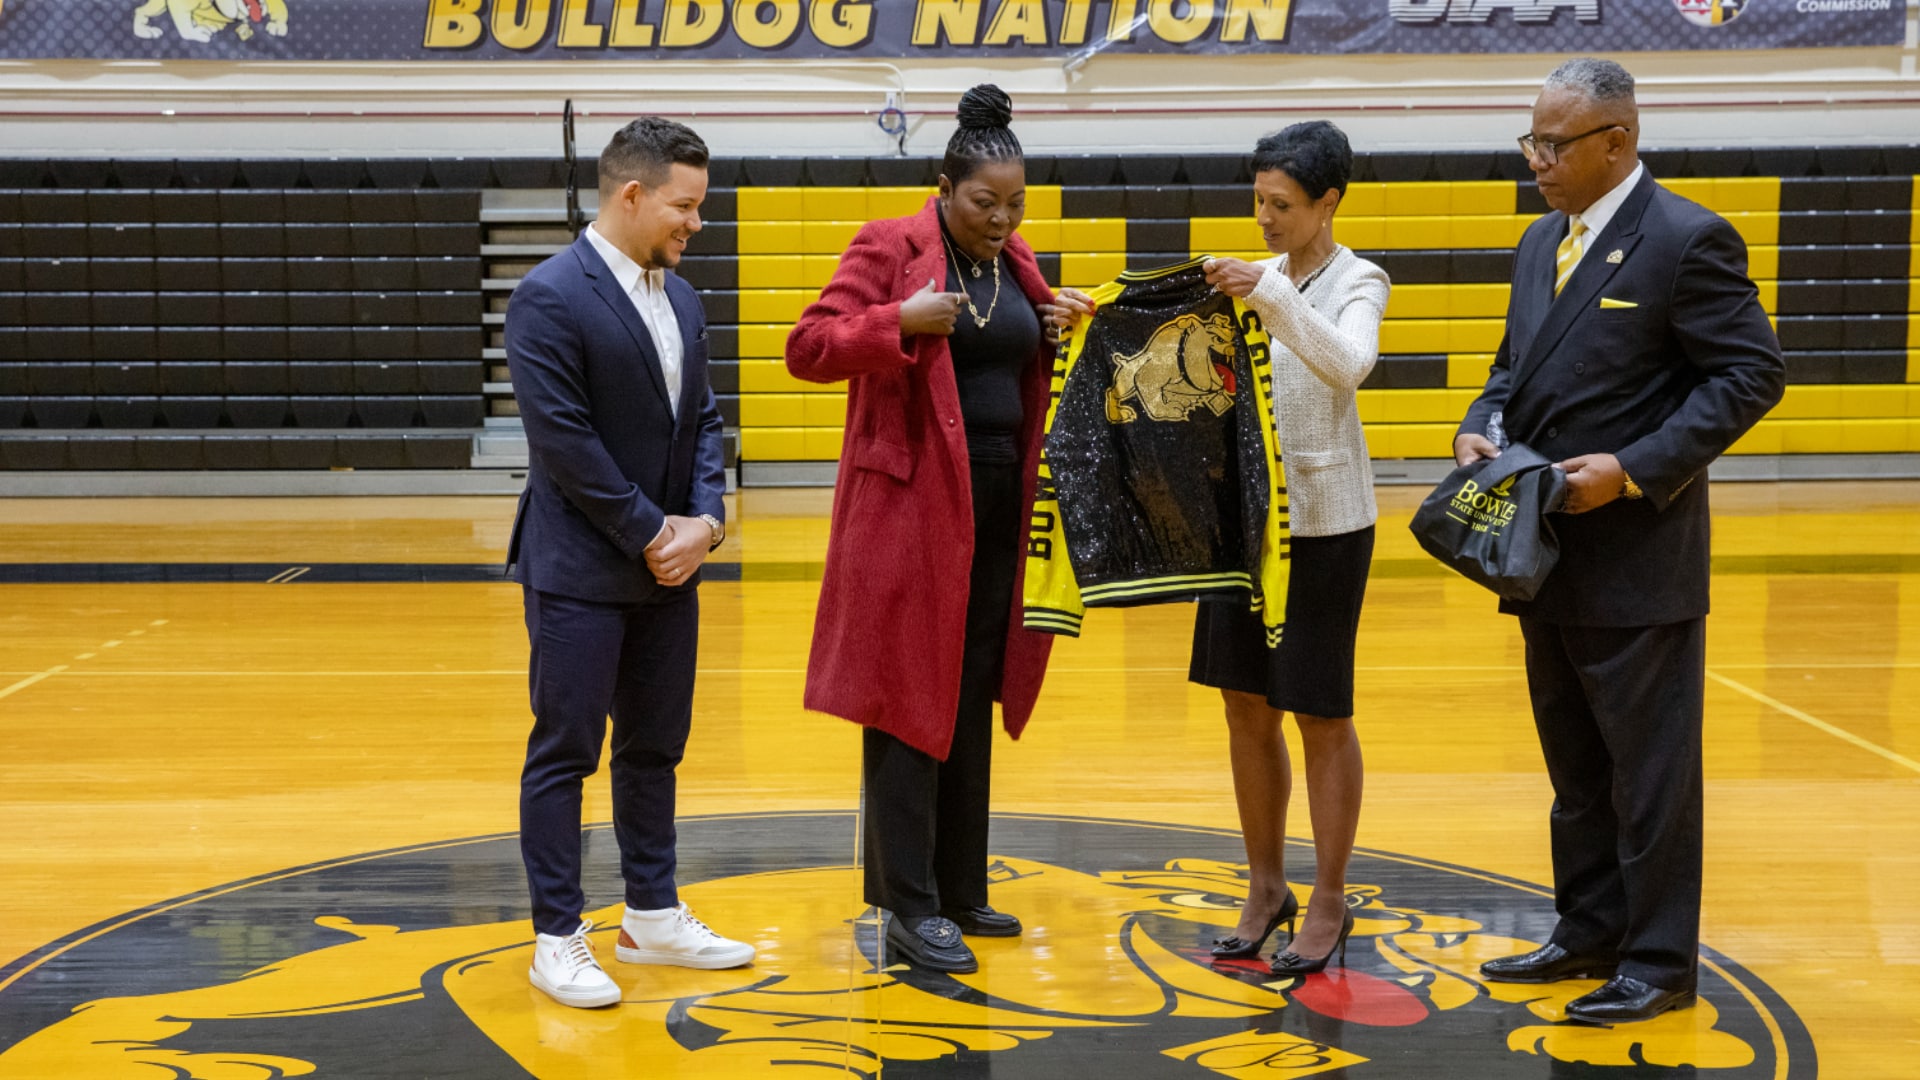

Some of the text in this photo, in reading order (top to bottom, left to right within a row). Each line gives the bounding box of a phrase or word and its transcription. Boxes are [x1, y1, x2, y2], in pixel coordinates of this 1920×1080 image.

[423, 0, 1291, 49] BULLDOG NATION
[1450, 498, 1474, 516] STATE
[1455, 479, 1518, 520] BOWIE
